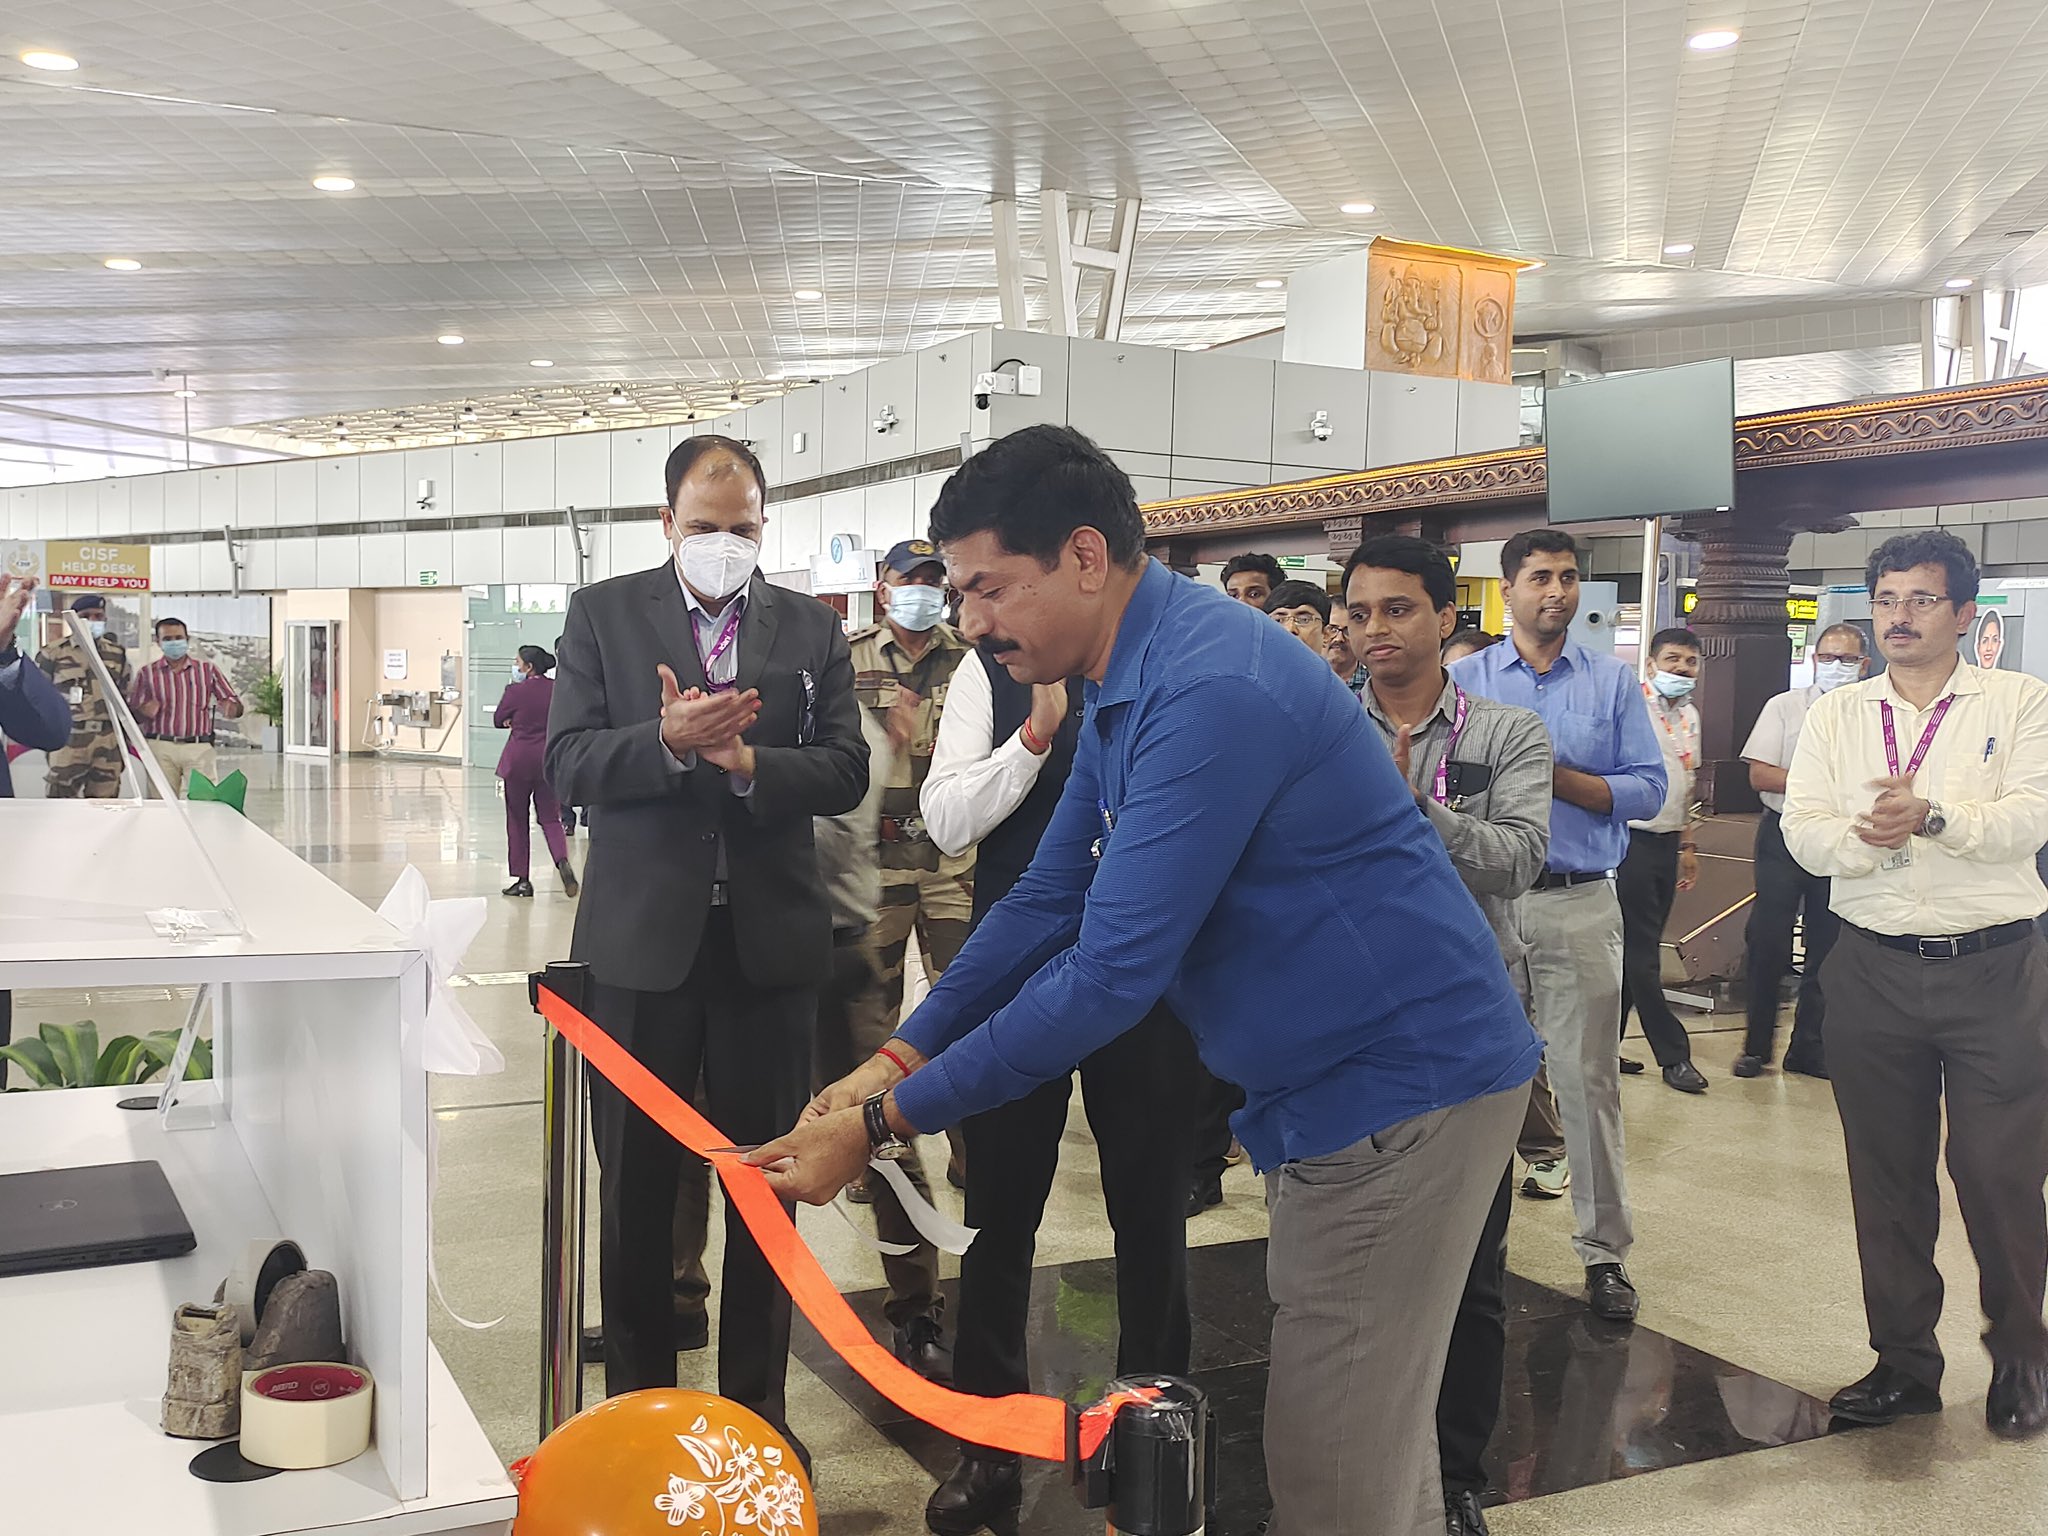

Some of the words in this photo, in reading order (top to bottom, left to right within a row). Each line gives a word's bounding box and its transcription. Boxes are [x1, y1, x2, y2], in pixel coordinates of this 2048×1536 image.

[80, 547, 118, 560] CISF
[62, 562, 97, 572] HELP
[100, 563, 136, 574] DESK
[51, 575, 79, 585] MAY
[81, 577, 86, 586] I
[88, 578, 119, 587] HELP
[120, 579, 147, 588] YOU
